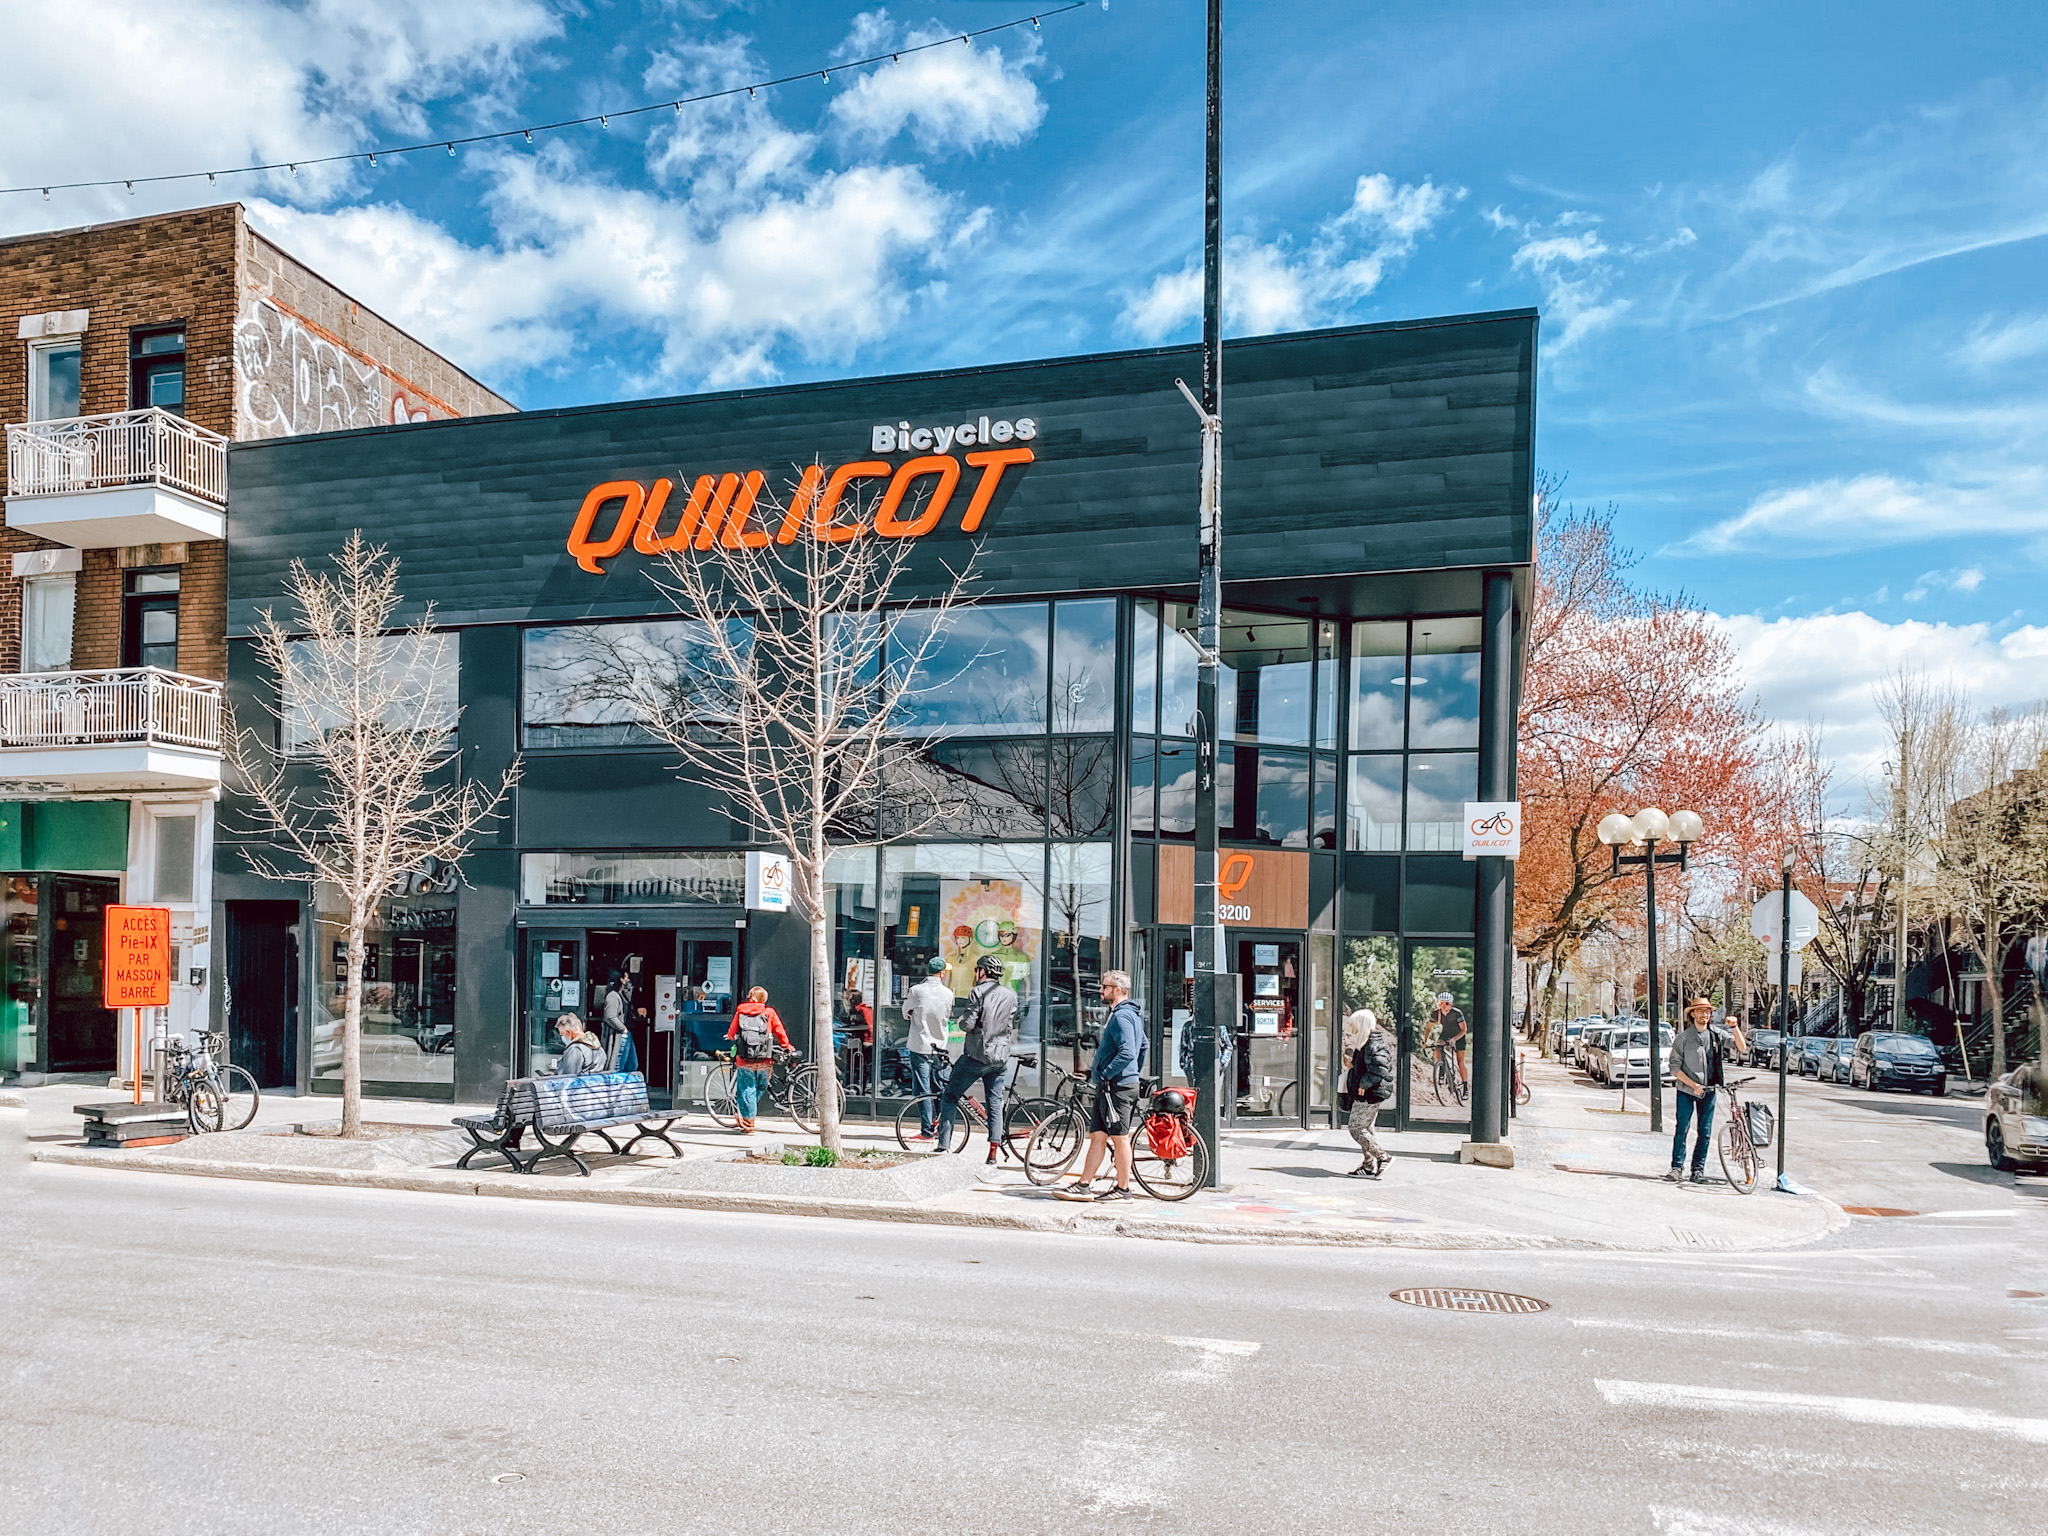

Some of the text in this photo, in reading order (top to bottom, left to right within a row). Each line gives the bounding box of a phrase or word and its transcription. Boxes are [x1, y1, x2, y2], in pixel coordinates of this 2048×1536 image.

[871, 416, 1037, 454] Bicycles
[566, 447, 1035, 574] QUILICOT
[1472, 839, 1512, 847] QUILICOT
[1219, 904, 1251, 921] 3200
[122, 915, 157, 931] ACCÈS
[120, 935, 157, 949] Pie-IX
[128, 953, 150, 966] PAR
[116, 969, 161, 981] MASSON
[121, 982, 157, 998] BARRÉ
[1253, 999, 1285, 1007] SERVICES
